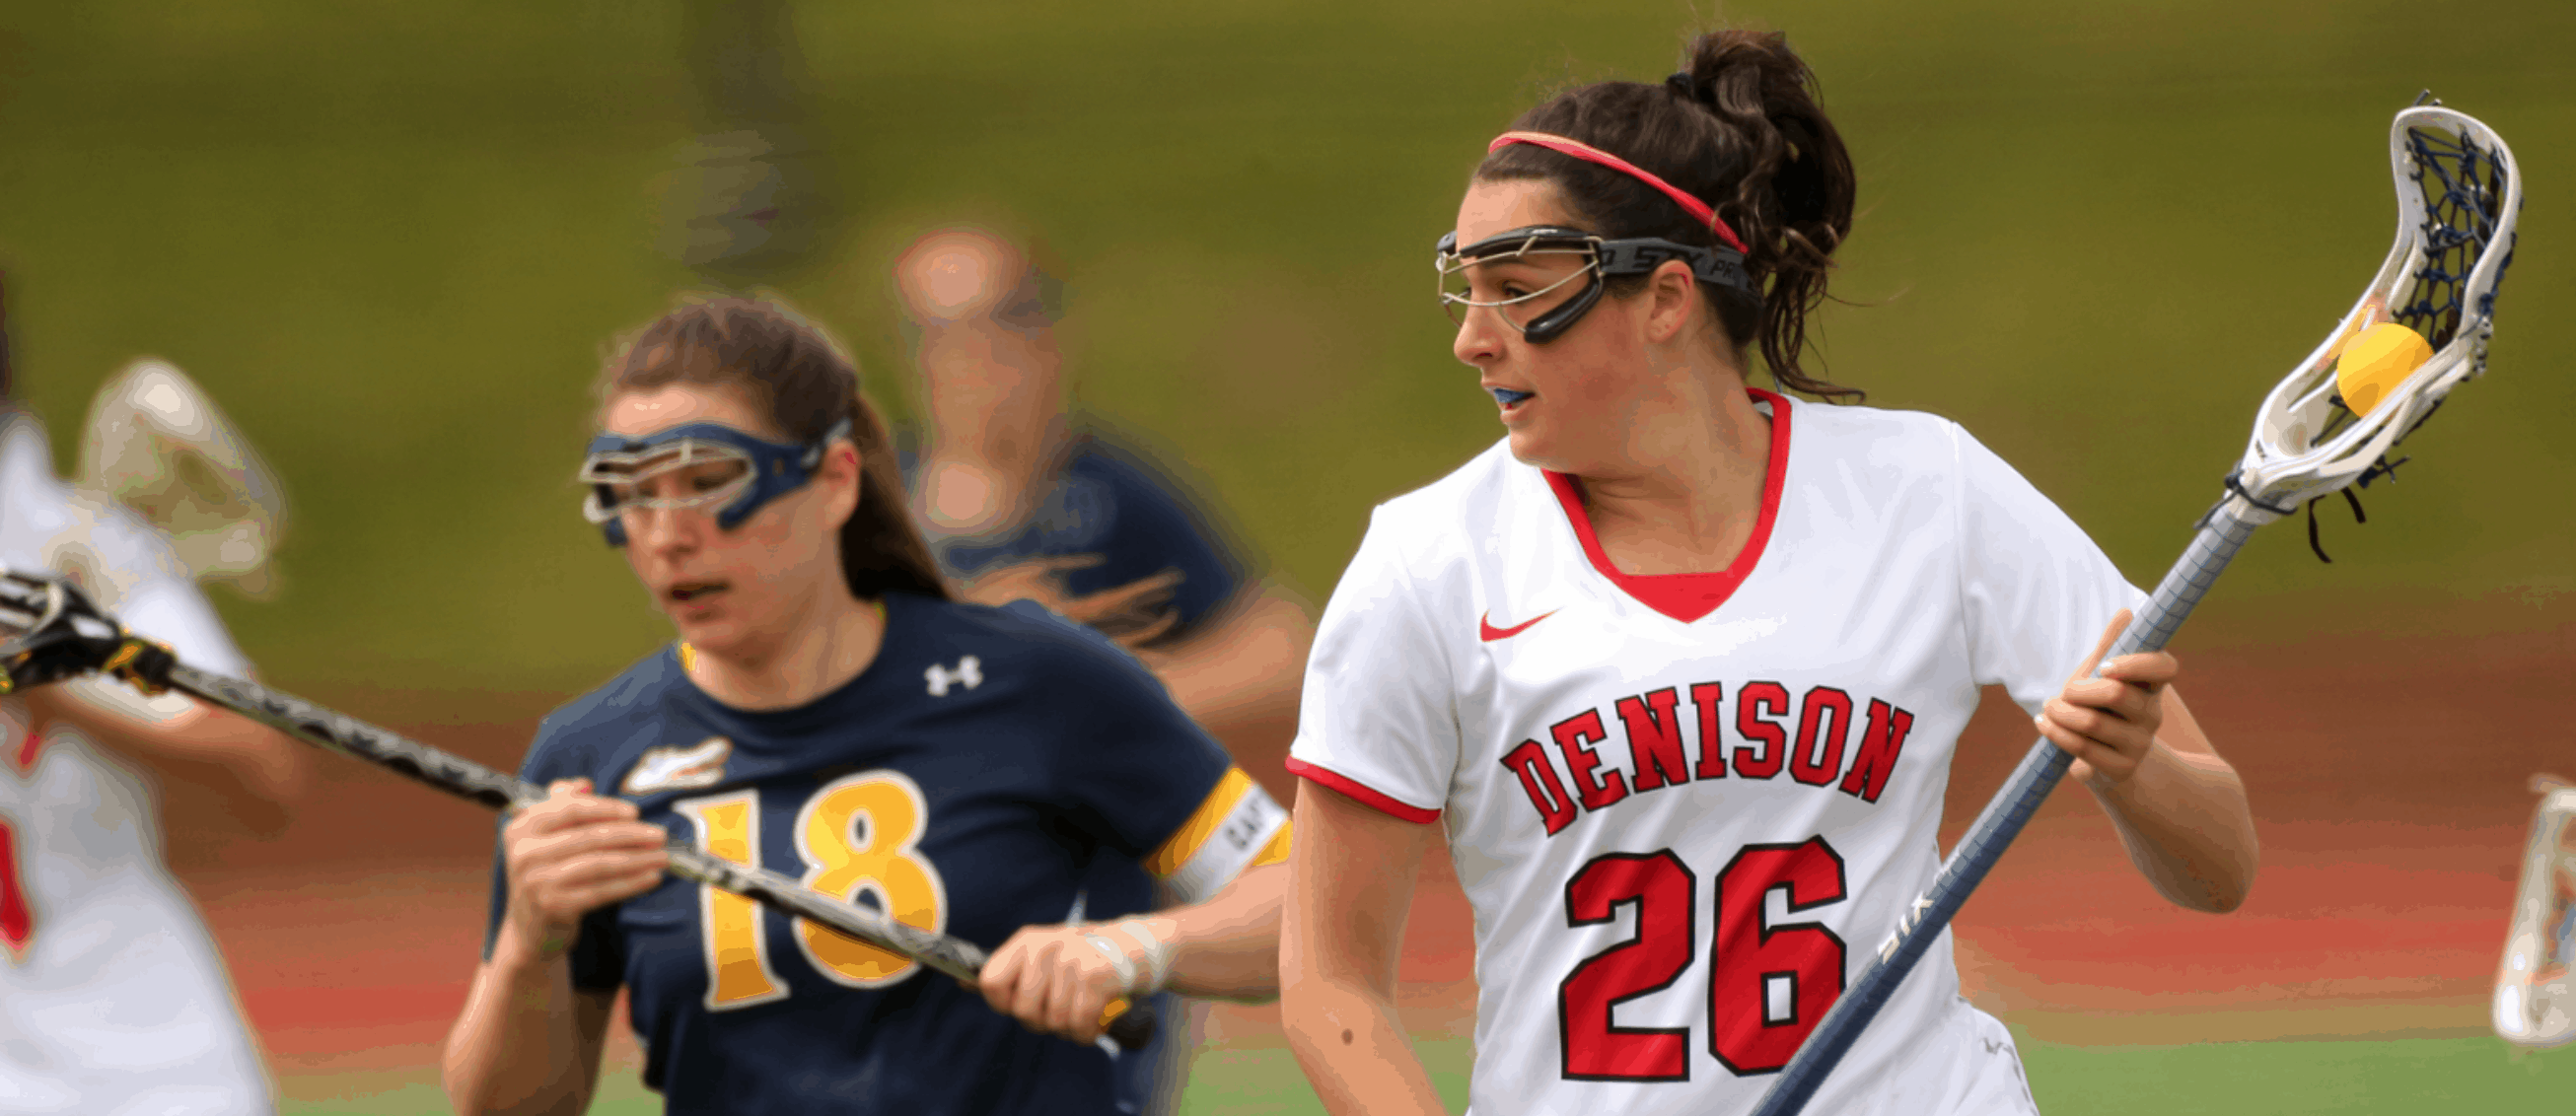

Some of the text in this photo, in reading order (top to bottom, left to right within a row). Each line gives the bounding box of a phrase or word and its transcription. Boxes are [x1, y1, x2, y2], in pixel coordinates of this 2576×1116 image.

[1500, 680, 1914, 837] DENISON
[671, 768, 948, 1012] 18
[1558, 834, 1847, 1082] 26
